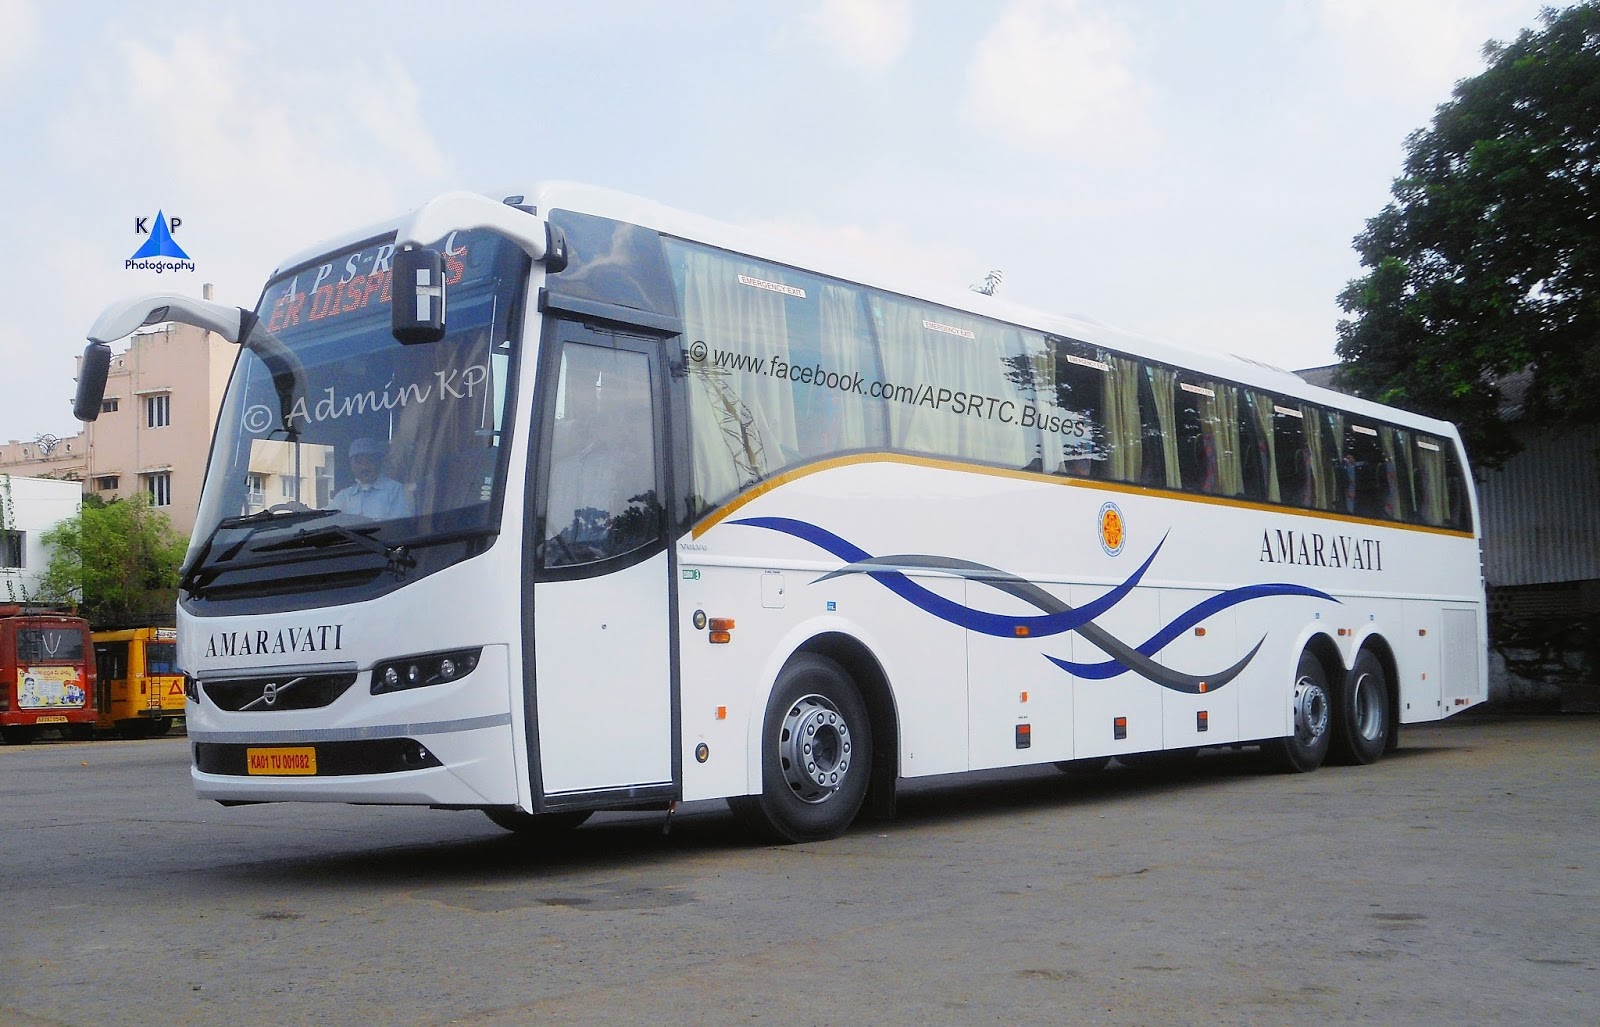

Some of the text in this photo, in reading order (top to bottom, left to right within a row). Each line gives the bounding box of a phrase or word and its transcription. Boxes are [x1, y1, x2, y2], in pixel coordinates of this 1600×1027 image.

[267, 245, 468, 333] ER DISPLS
[741, 276, 802, 296] EMERGENCY EXIT
[925, 321, 972, 338] EMERGENCY EXIT
[1259, 528, 1383, 571] AMARAVATI
[205, 624, 343, 657] AMARAVATI
[251, 754, 309, 769] KA01 TU 001082
